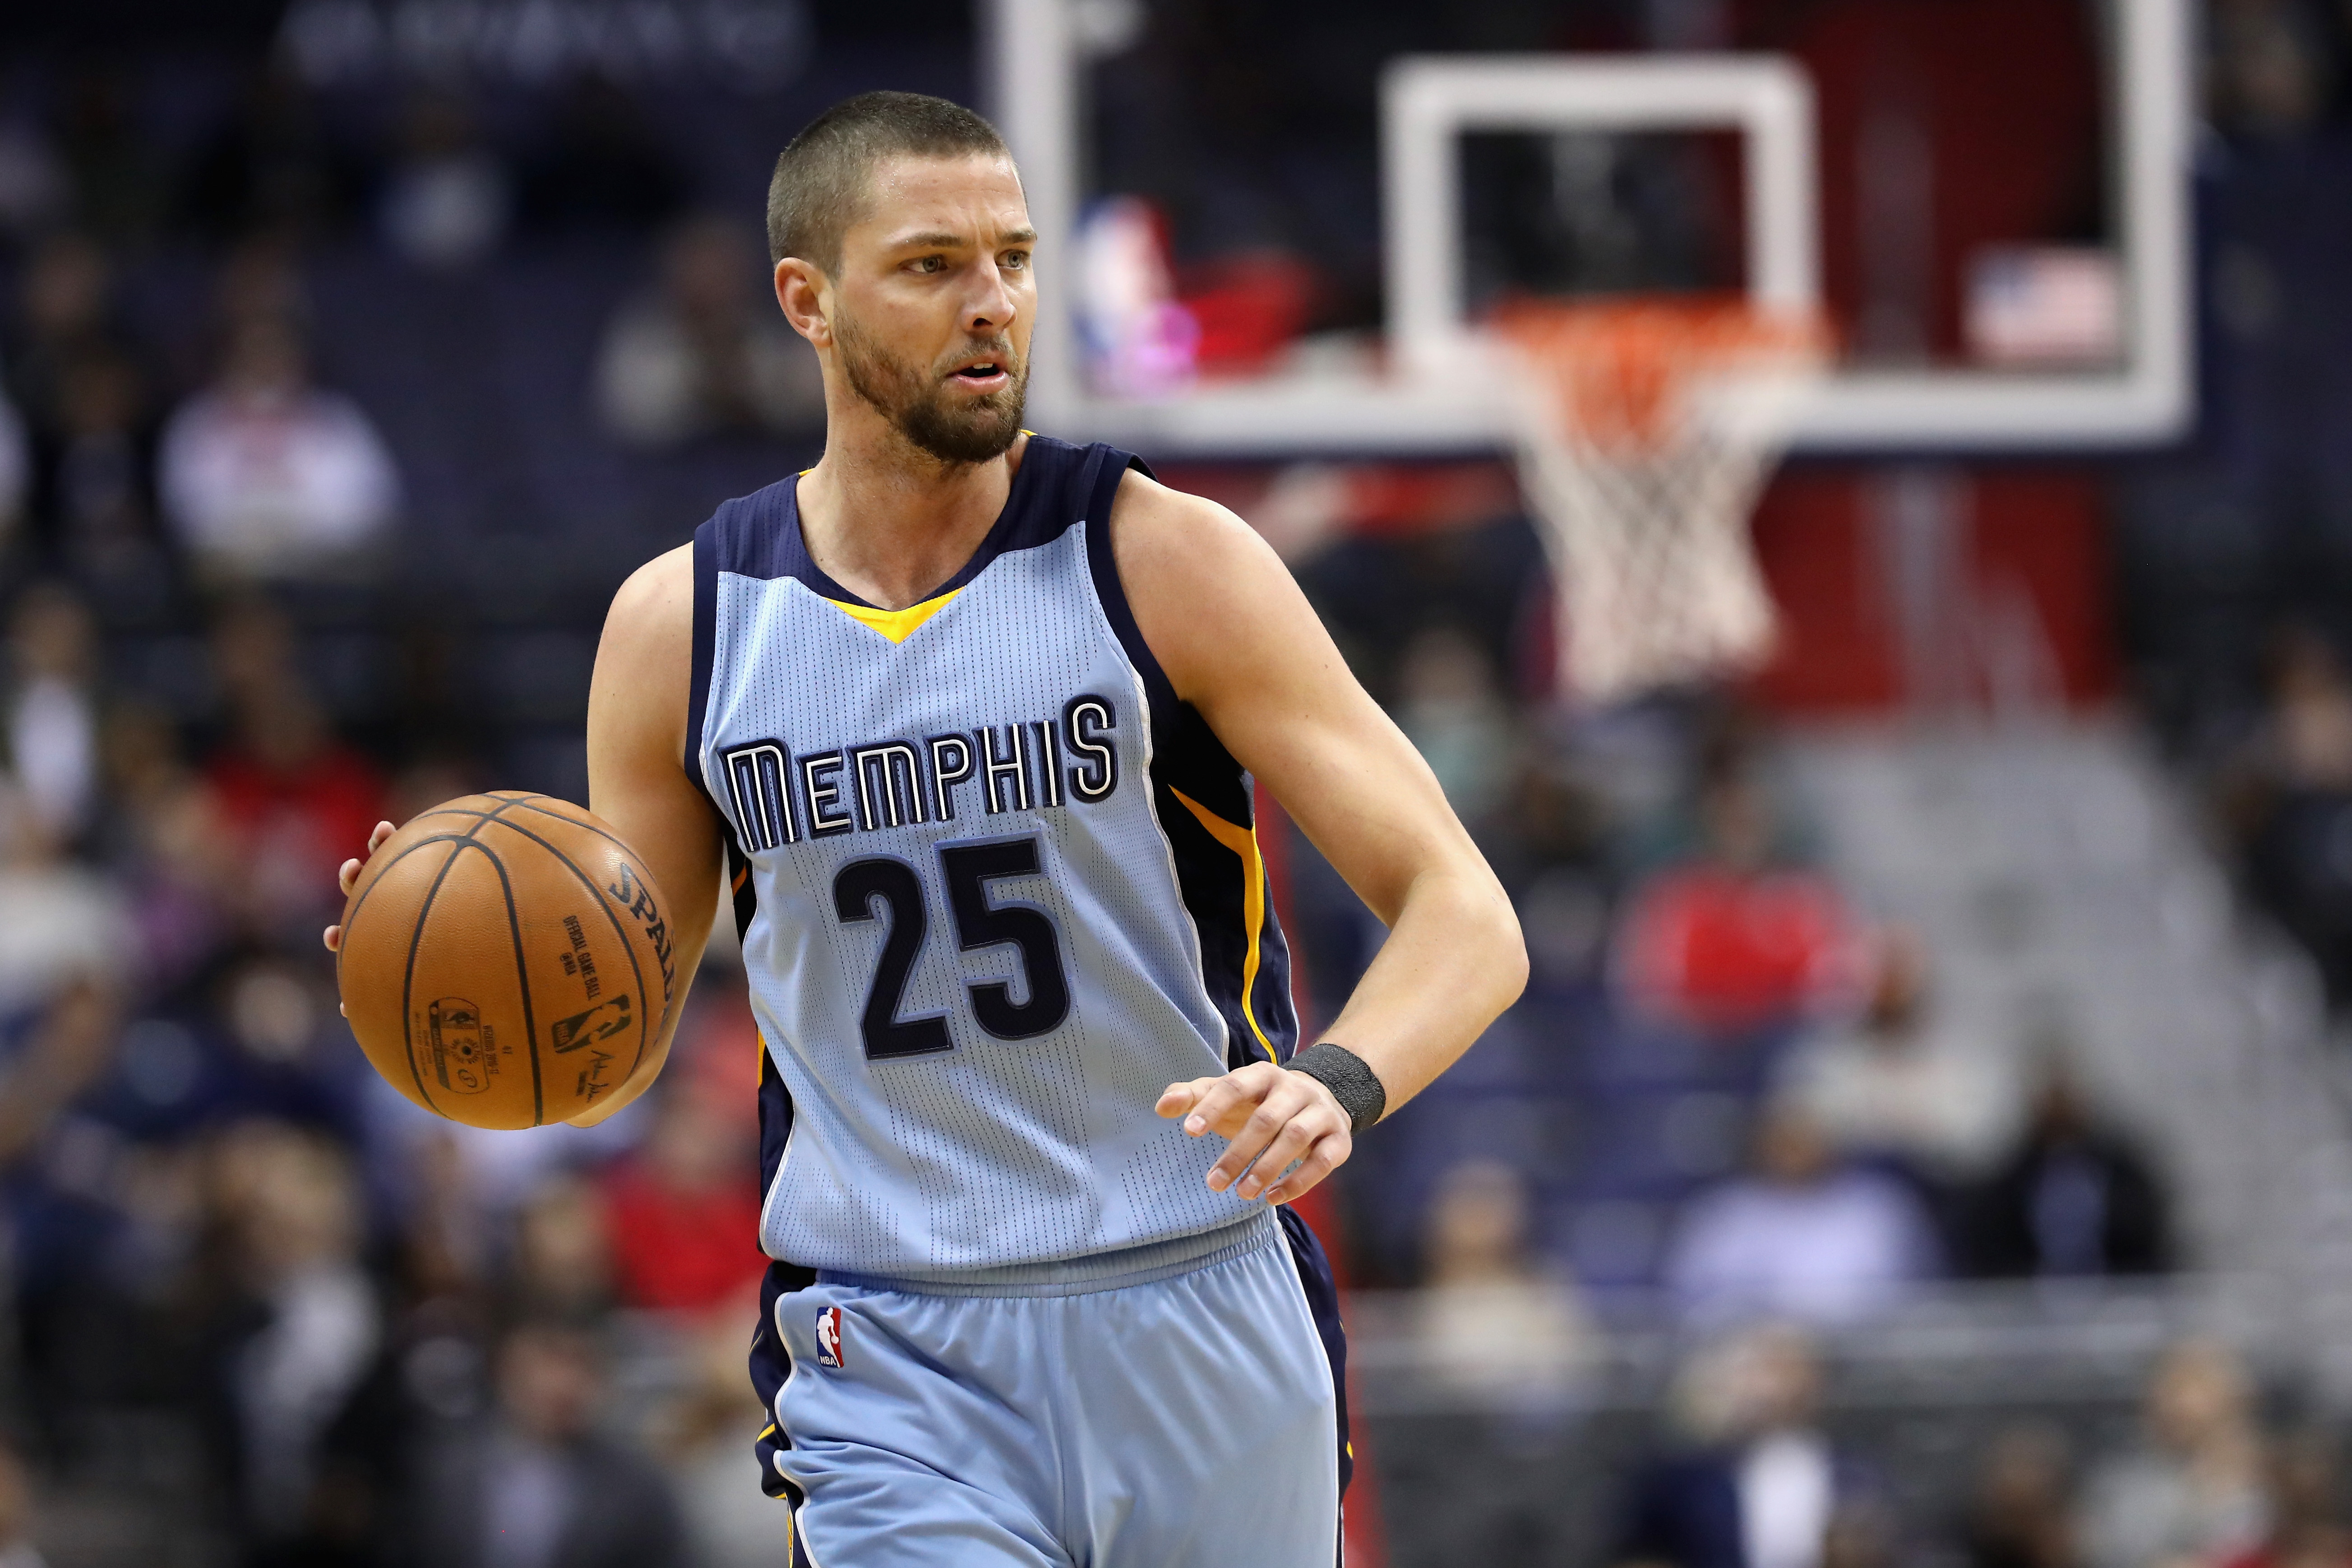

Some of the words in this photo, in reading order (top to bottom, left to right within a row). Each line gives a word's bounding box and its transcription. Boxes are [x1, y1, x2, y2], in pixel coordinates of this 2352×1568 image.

[716, 692, 1118, 853] MEMPHIS
[563, 915, 587, 953] OFFICIAL
[609, 862, 674, 1046] SPALD
[832, 831, 1075, 1064] 25
[559, 952, 577, 976] @NBA
[578, 952, 596, 978] GAME
[585, 977, 601, 1000] BALL
[556, 1022, 570, 1044] NBA
[820, 1356, 836, 1365] NBA
